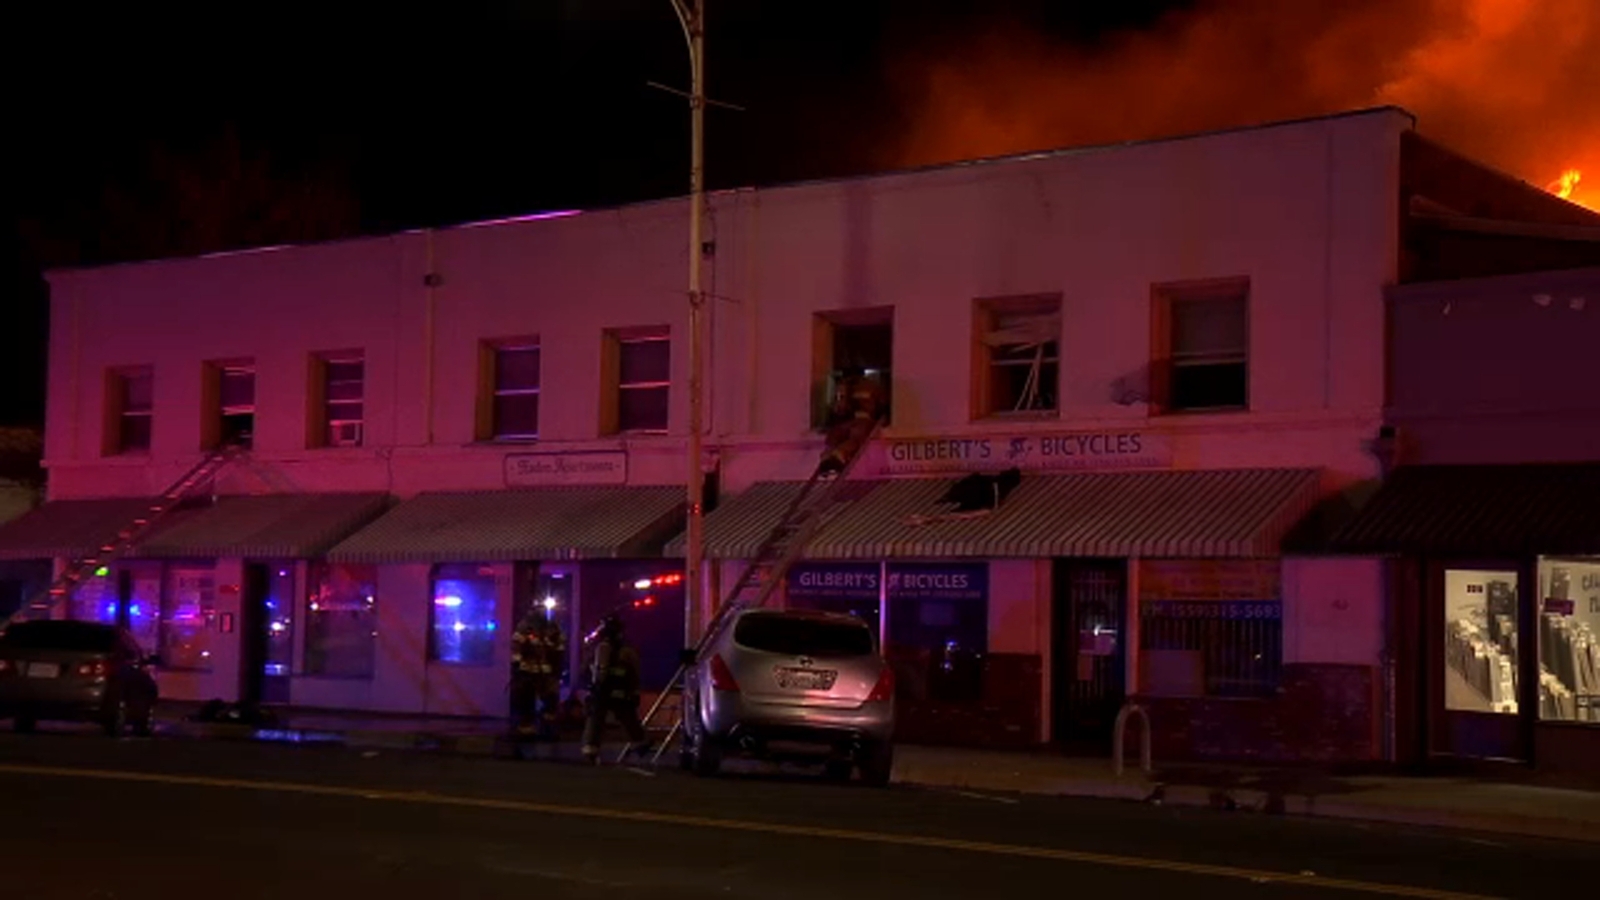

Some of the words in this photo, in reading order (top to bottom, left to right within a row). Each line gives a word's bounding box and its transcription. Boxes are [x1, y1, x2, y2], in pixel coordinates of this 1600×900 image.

[891, 439, 992, 461] GILBERT'S
[1040, 433, 1142, 456] BICYCLES
[799, 571, 877, 588] GILBERT'S
[903, 573, 969, 588] BICYCLES
